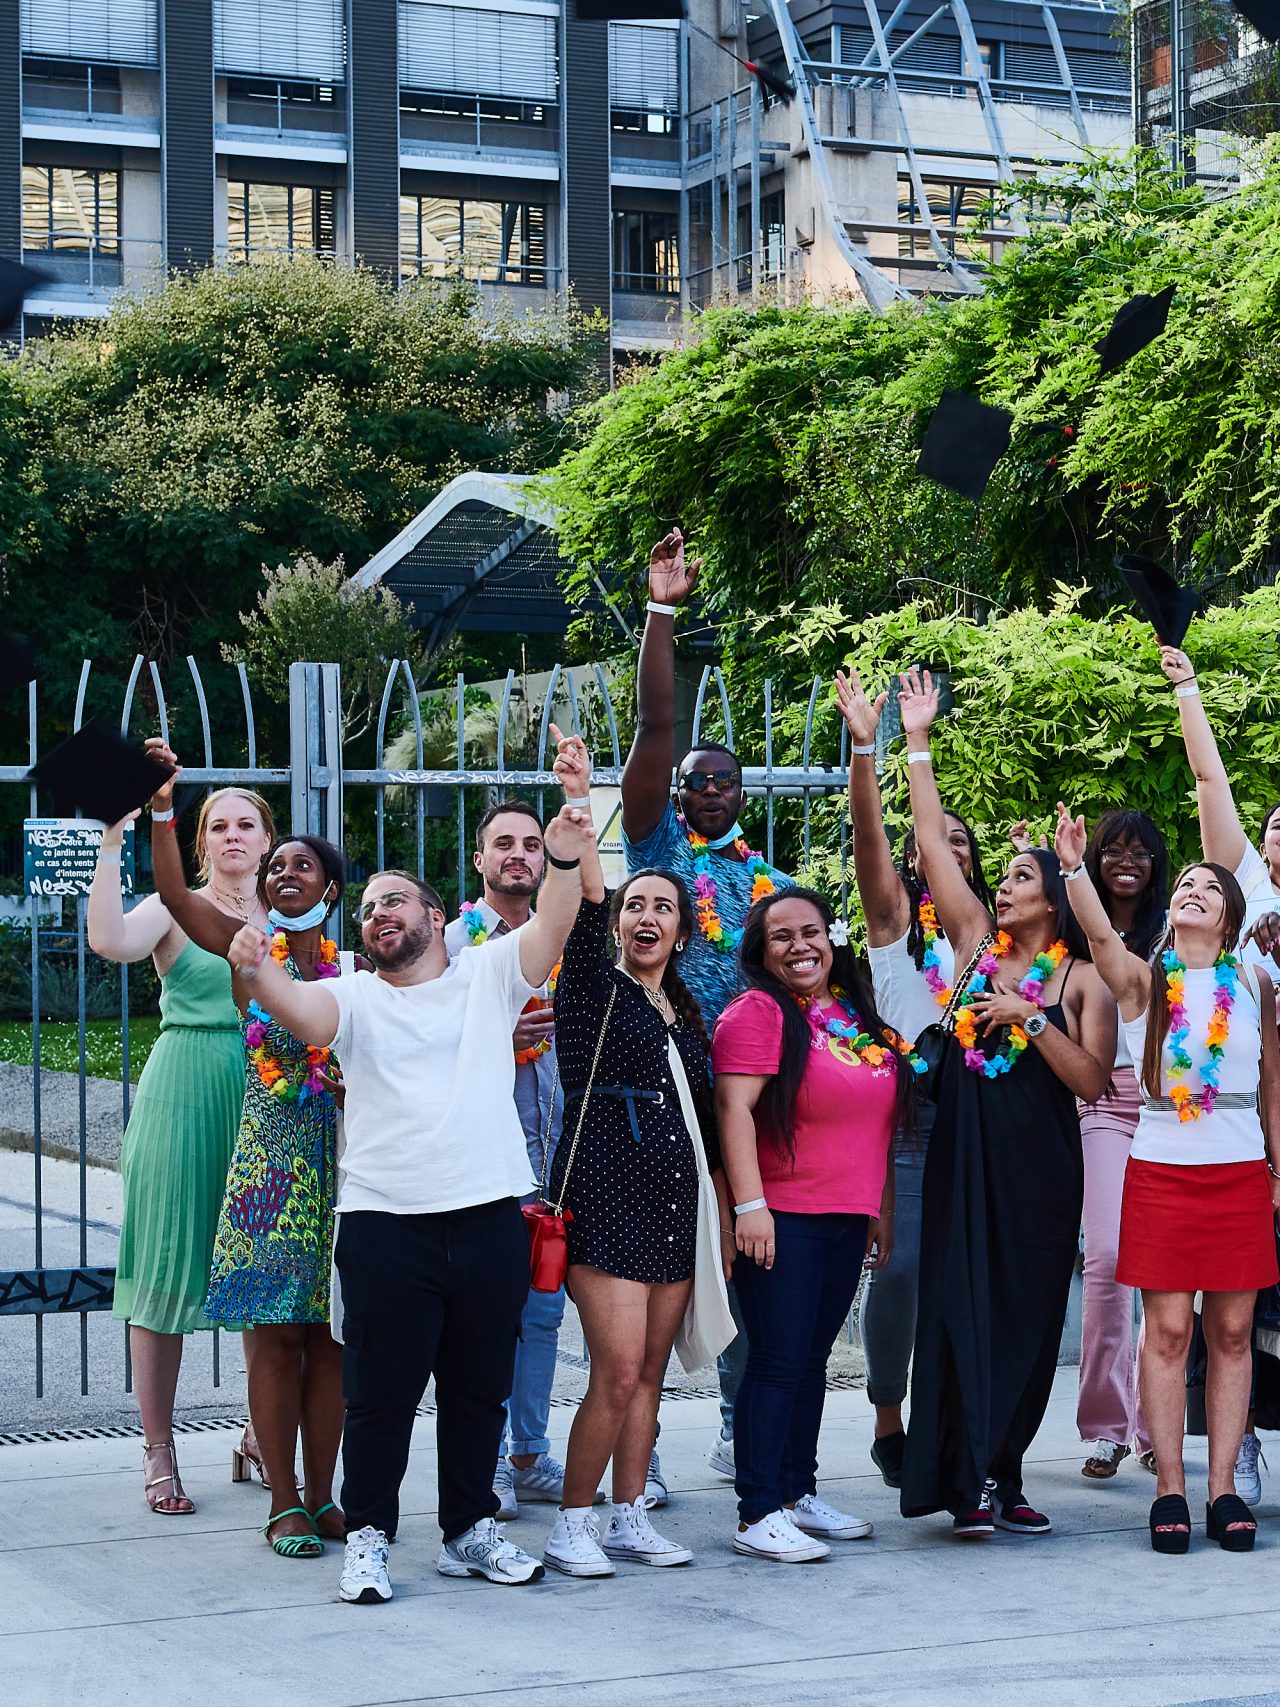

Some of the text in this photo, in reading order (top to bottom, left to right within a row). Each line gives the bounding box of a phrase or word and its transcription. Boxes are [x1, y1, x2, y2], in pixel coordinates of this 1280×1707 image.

[54, 848, 76, 858] jardin
[62, 858, 72, 867] de
[74, 859, 95, 867] vents
